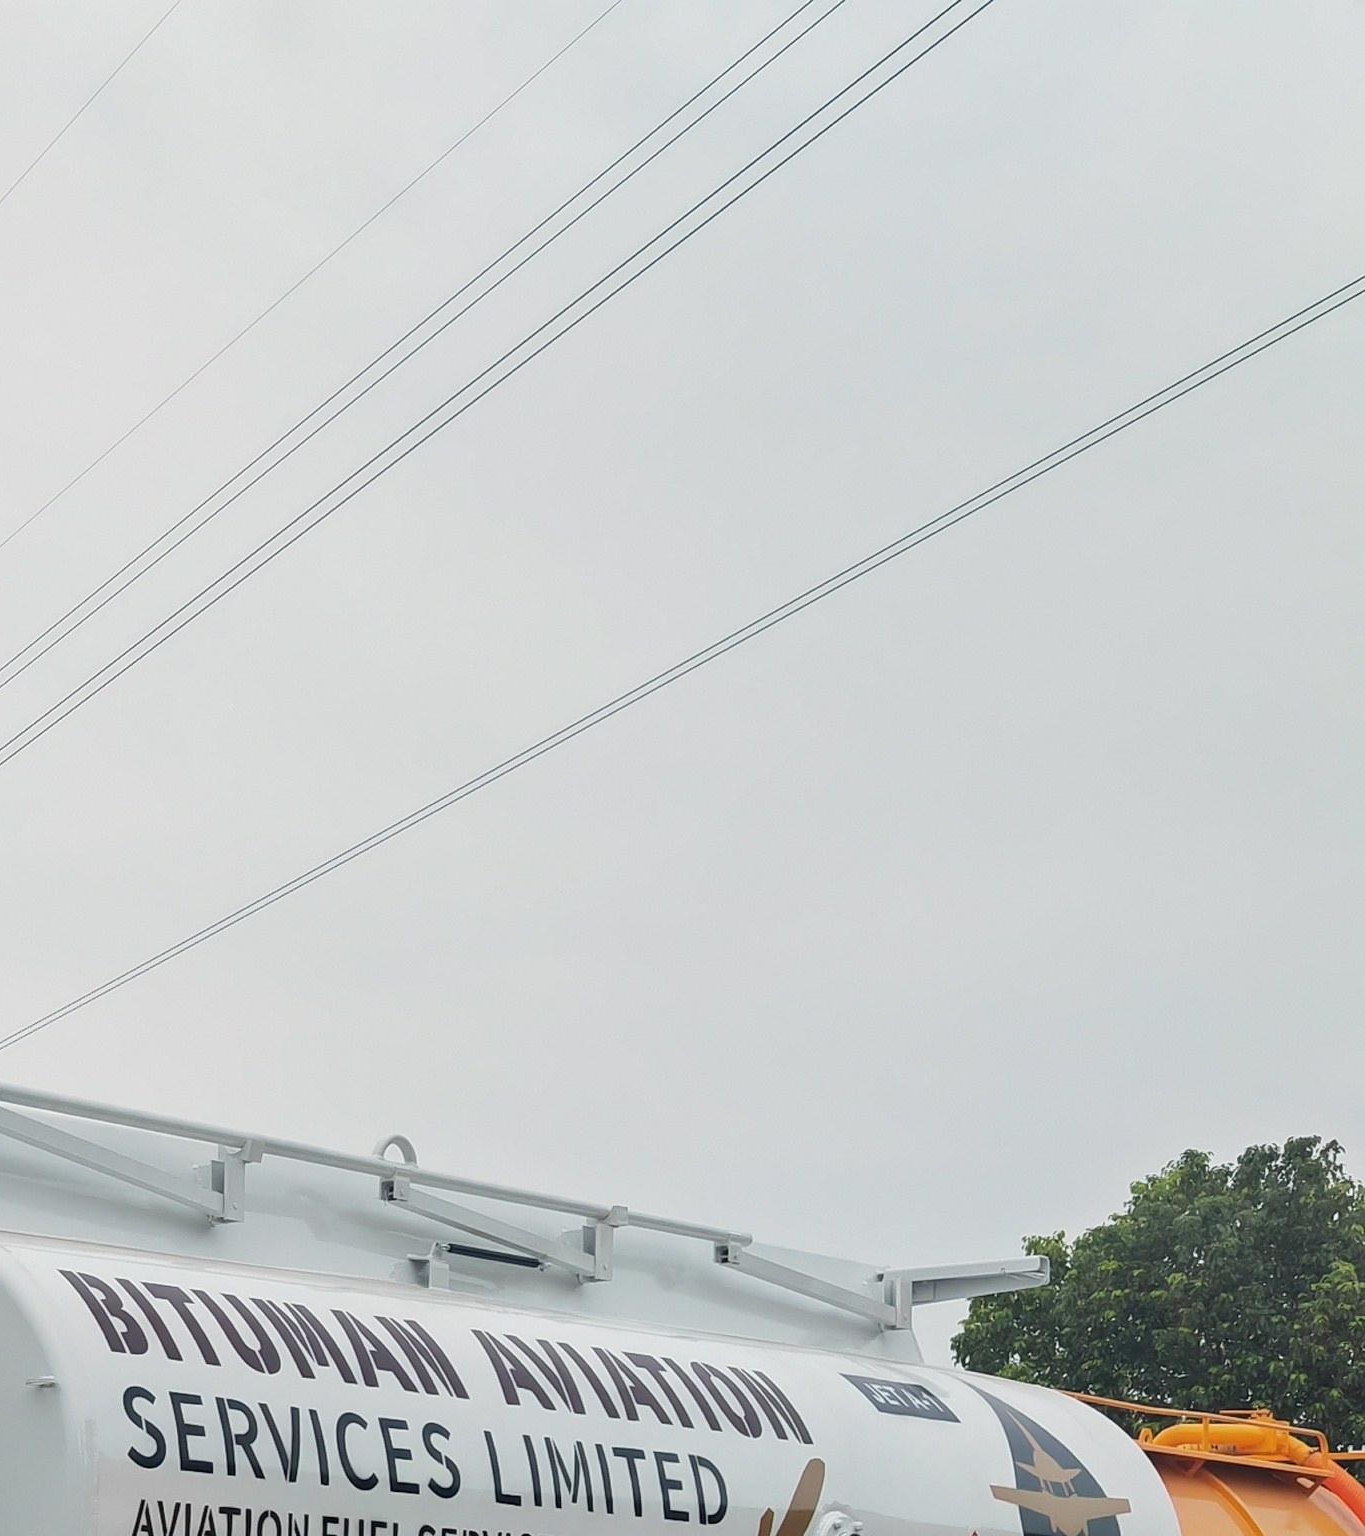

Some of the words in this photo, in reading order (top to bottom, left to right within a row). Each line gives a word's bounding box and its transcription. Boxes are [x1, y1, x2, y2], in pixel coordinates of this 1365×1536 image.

[57, 1269, 470, 1400] BITUMAN
[470, 1329, 814, 1445] AVIATION
[862, 1382, 910, 1407] JET
[122, 1385, 462, 1499] SERVICES
[483, 1430, 729, 1526] LIMITED
